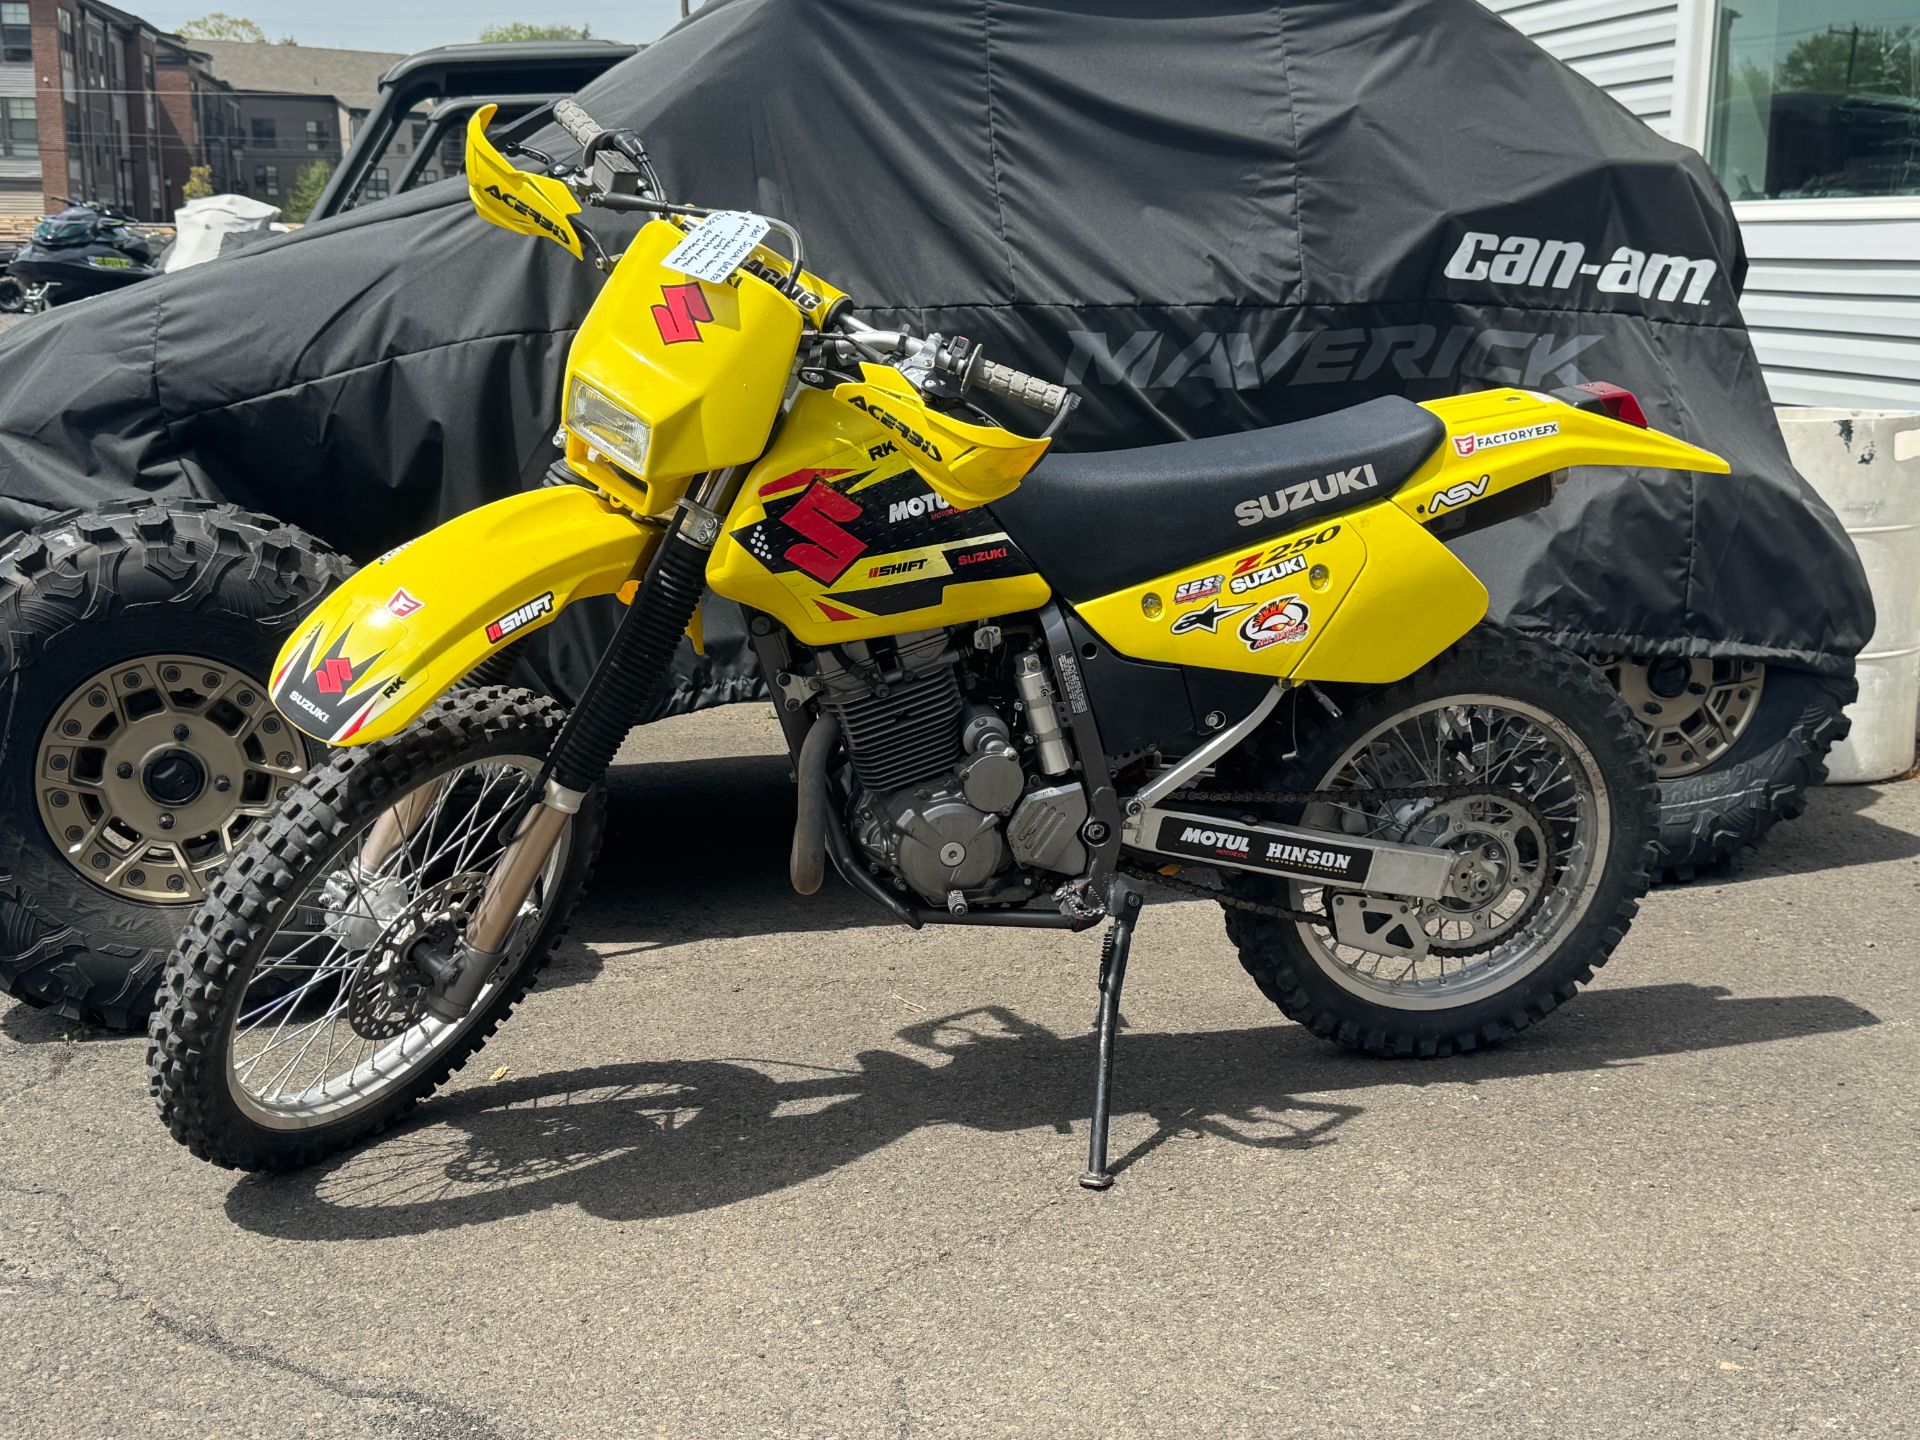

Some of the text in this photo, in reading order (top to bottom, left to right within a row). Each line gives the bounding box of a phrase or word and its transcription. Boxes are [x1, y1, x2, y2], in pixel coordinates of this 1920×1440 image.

[1063, 325, 1604, 390] MAVERICK
[868, 440, 899, 462] RK
[888, 492, 951, 523] MOTU
[1234, 463, 1379, 527] SUZUKI
[1429, 475, 1489, 513] ASV
[878, 558, 929, 577] SHIFT
[958, 547, 1008, 566] SUZUKI
[1230, 555, 1308, 594] SUZUKI
[498, 593, 552, 635] SHIFT
[382, 676, 408, 699] RK
[289, 690, 330, 724] SUZUKI
[1180, 827, 1351, 869] MOTUL HINSON
